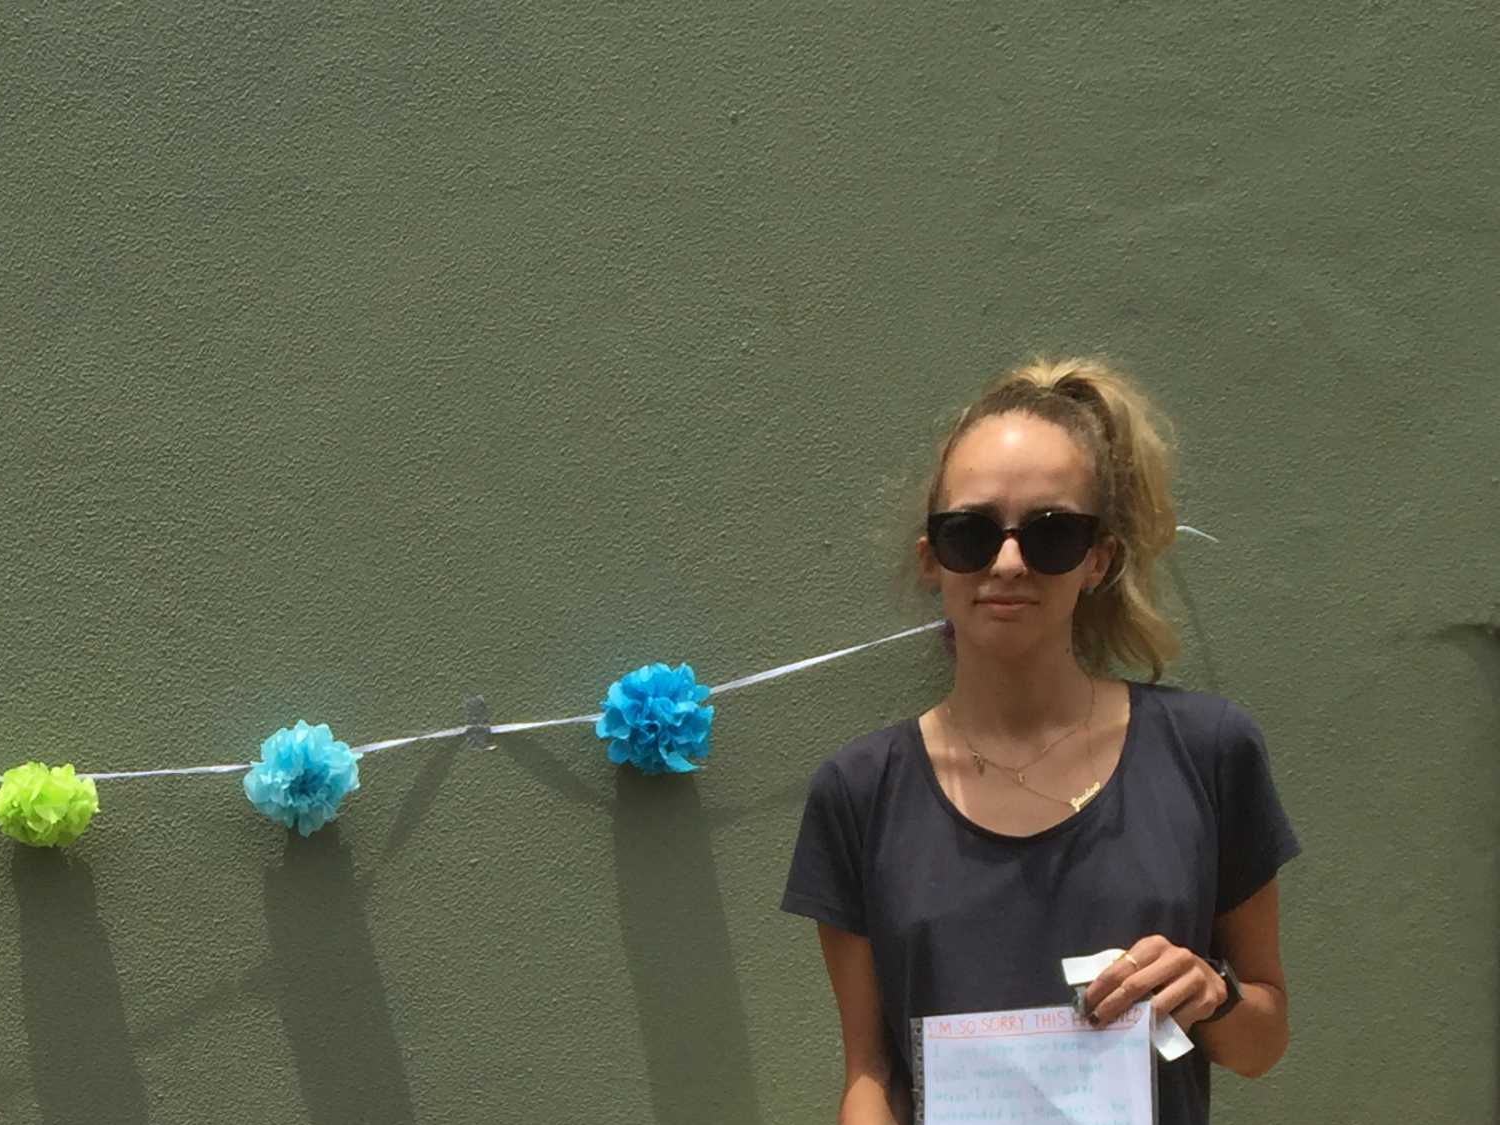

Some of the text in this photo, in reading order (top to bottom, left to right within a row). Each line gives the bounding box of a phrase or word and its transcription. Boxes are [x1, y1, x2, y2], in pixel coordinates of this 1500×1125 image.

[959, 1020, 977, 1035] SO
[981, 1015, 1026, 1034] SORRY
[1034, 1011, 1067, 1029] THIS
